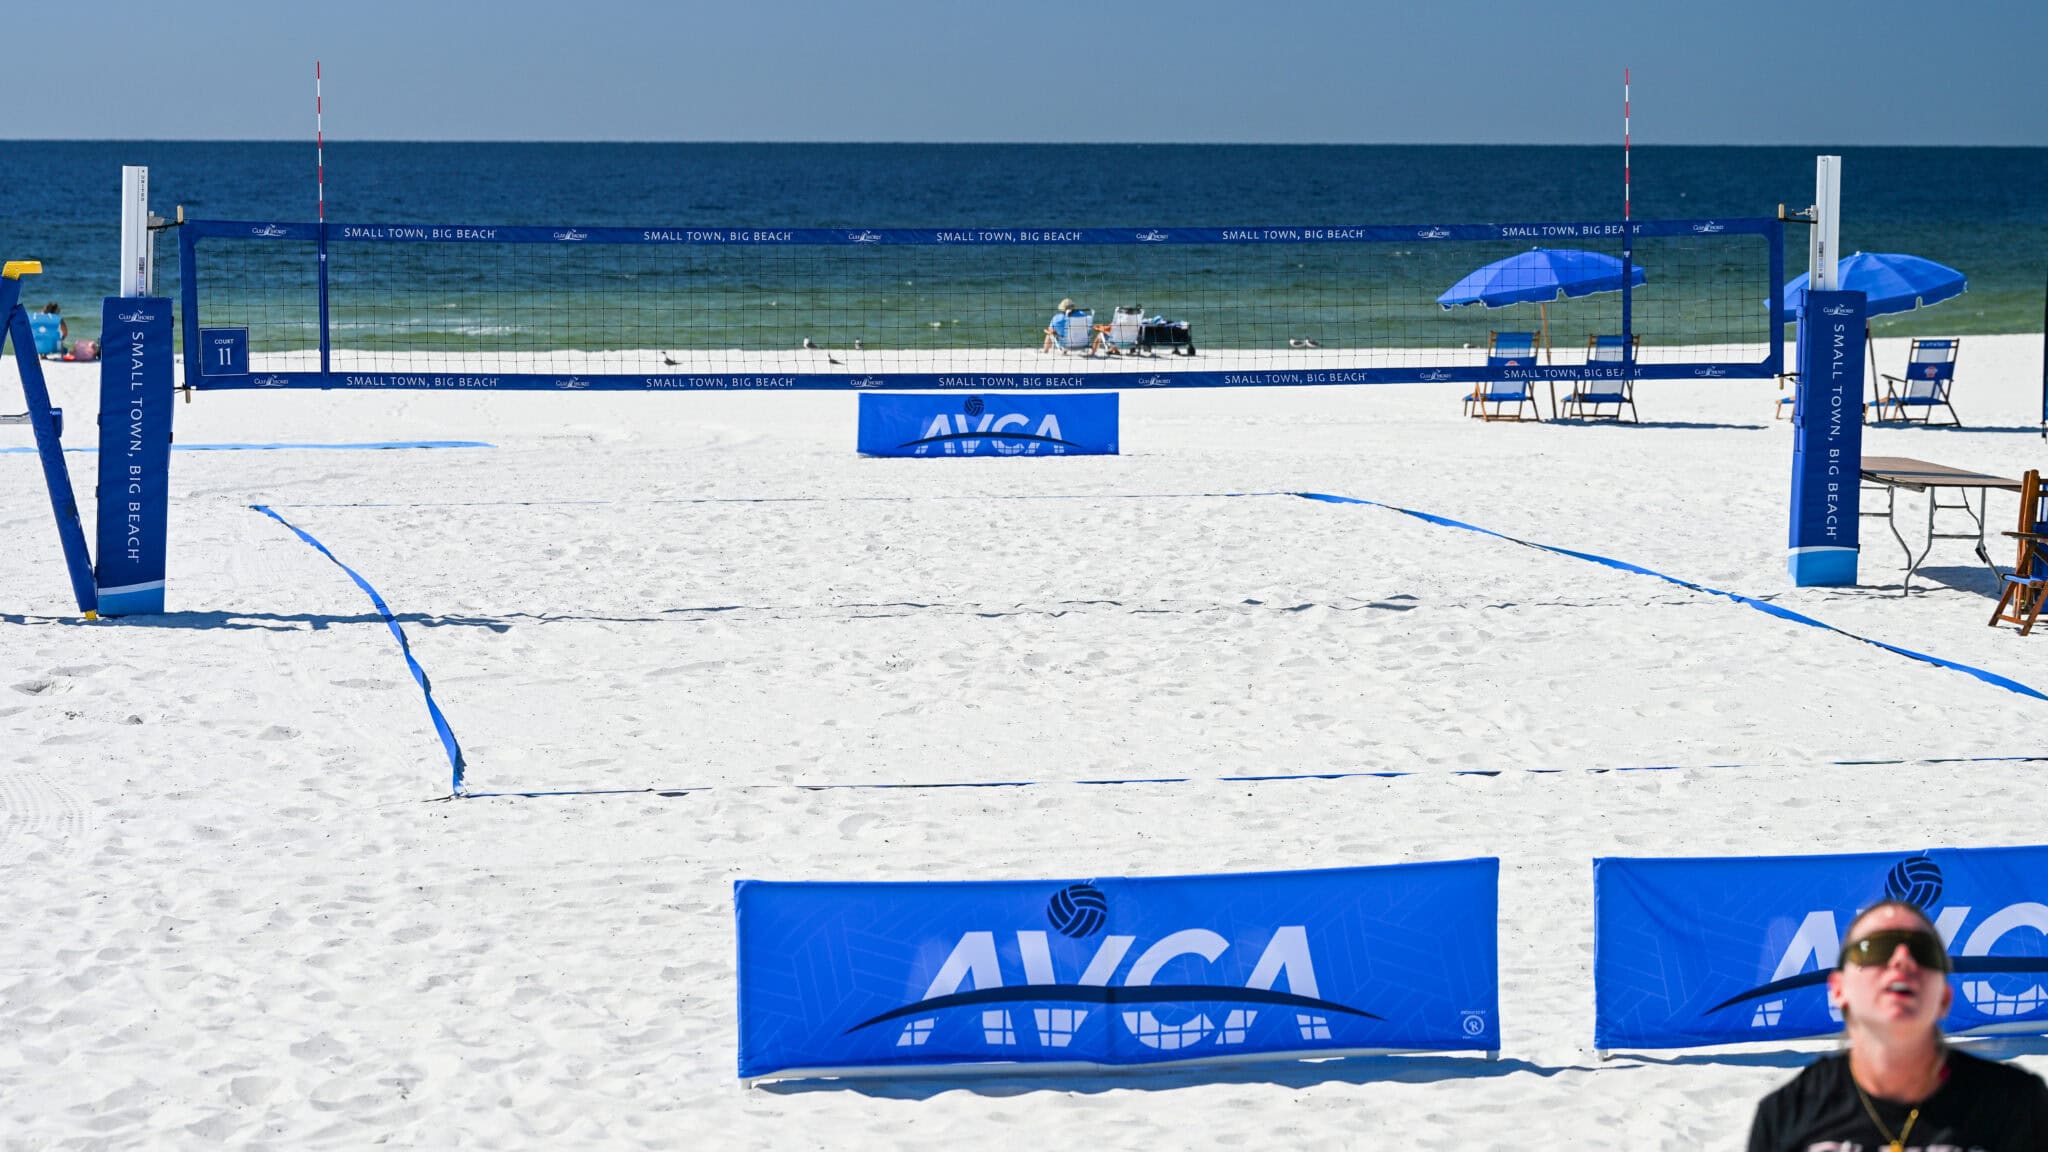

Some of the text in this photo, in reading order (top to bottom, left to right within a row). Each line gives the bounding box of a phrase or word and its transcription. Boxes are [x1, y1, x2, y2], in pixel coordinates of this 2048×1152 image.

[344, 227, 384, 238] SMALL
[388, 228, 428, 240] TOWN,
[432, 228, 452, 239] BIG
[644, 231, 683, 241] SMALL
[686, 231, 726, 243] TOWN,
[730, 231, 749, 241] BIG
[936, 232, 974, 242] SMALL
[978, 231, 1016, 243] TOWN,
[1020, 231, 1040, 241] BIG
[1222, 230, 1259, 240] SMALL
[1263, 230, 1301, 242] TOWN,
[1304, 229, 1323, 239] BIG
[1502, 225, 1641, 238] SMALL TOWN, BIG BEAH
[217, 347, 232, 366] 11
[1831, 323, 1845, 380] SMALL
[131, 330, 144, 391] SMALL
[1224, 375, 1262, 384] SMALL
[1265, 374, 1303, 386] TOWN,
[1306, 373, 1325, 383] BIG
[1504, 368, 1641, 381] SMALL TOWN, BIG BEAH
[346, 376, 386, 386] SMALL
[390, 376, 430, 388] TOWN,
[434, 377, 454, 387] BIG
[646, 378, 685, 388] SMALL
[688, 377, 728, 389] TOWN,
[732, 377, 751, 387] BIG
[938, 377, 977, 387] SMALL
[980, 377, 1018, 389] TOWN,
[1023, 377, 1042, 387] BIG
[1828, 384, 1842, 442] TOWN,
[127, 397, 143, 458] TOWN,
[914, 413, 1065, 454] AVCA
[1828, 448, 1840, 476] BIG
[128, 466, 141, 495] BIG
[896, 925, 1332, 1049] AVCA
